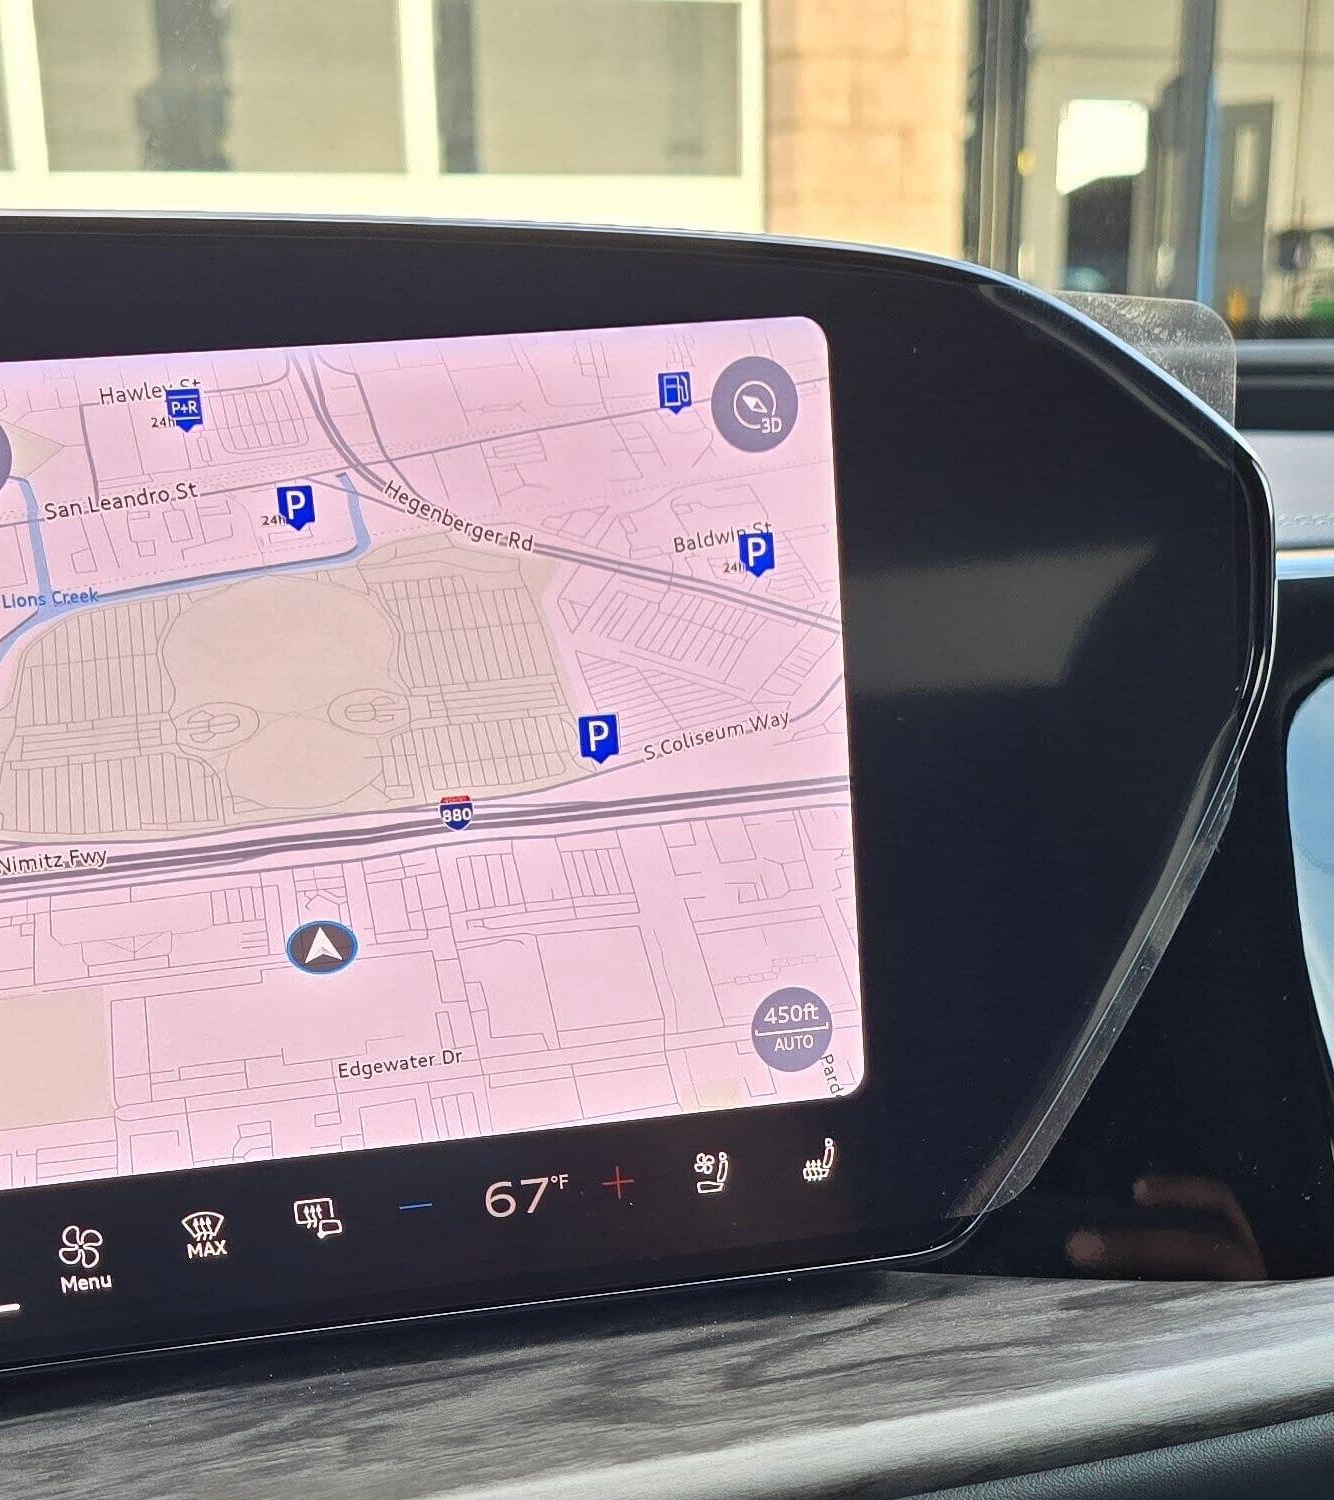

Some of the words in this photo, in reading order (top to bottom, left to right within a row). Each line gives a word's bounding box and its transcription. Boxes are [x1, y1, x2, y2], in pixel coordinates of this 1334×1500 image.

[151, 416, 175, 428] 24h
[761, 417, 783, 434] 3D
[45, 502, 82, 520] San
[88, 488, 170, 513] Leandro
[175, 482, 199, 500] St
[261, 513, 287, 527] 24h
[384, 480, 503, 543] Hegenberger
[509, 531, 534, 552] Rd
[1, 593, 47, 609] Lions
[52, 587, 100, 606] Creek
[644, 744, 656, 761] S
[660, 723, 745, 755] Coliseum
[749, 712, 790, 731] Way
[442, 808, 472, 823] 880
[69, 848, 107, 868] Fwy
[764, 1003, 820, 1025] 450ft
[774, 1034, 814, 1052] AUTO
[337, 1053, 437, 1079] Edgewater
[441, 1049, 463, 1067] Dr
[819, 1054, 845, 1095] Pard
[187, 1238, 228, 1259] MAX
[60, 1271, 113, 1295] Menu
